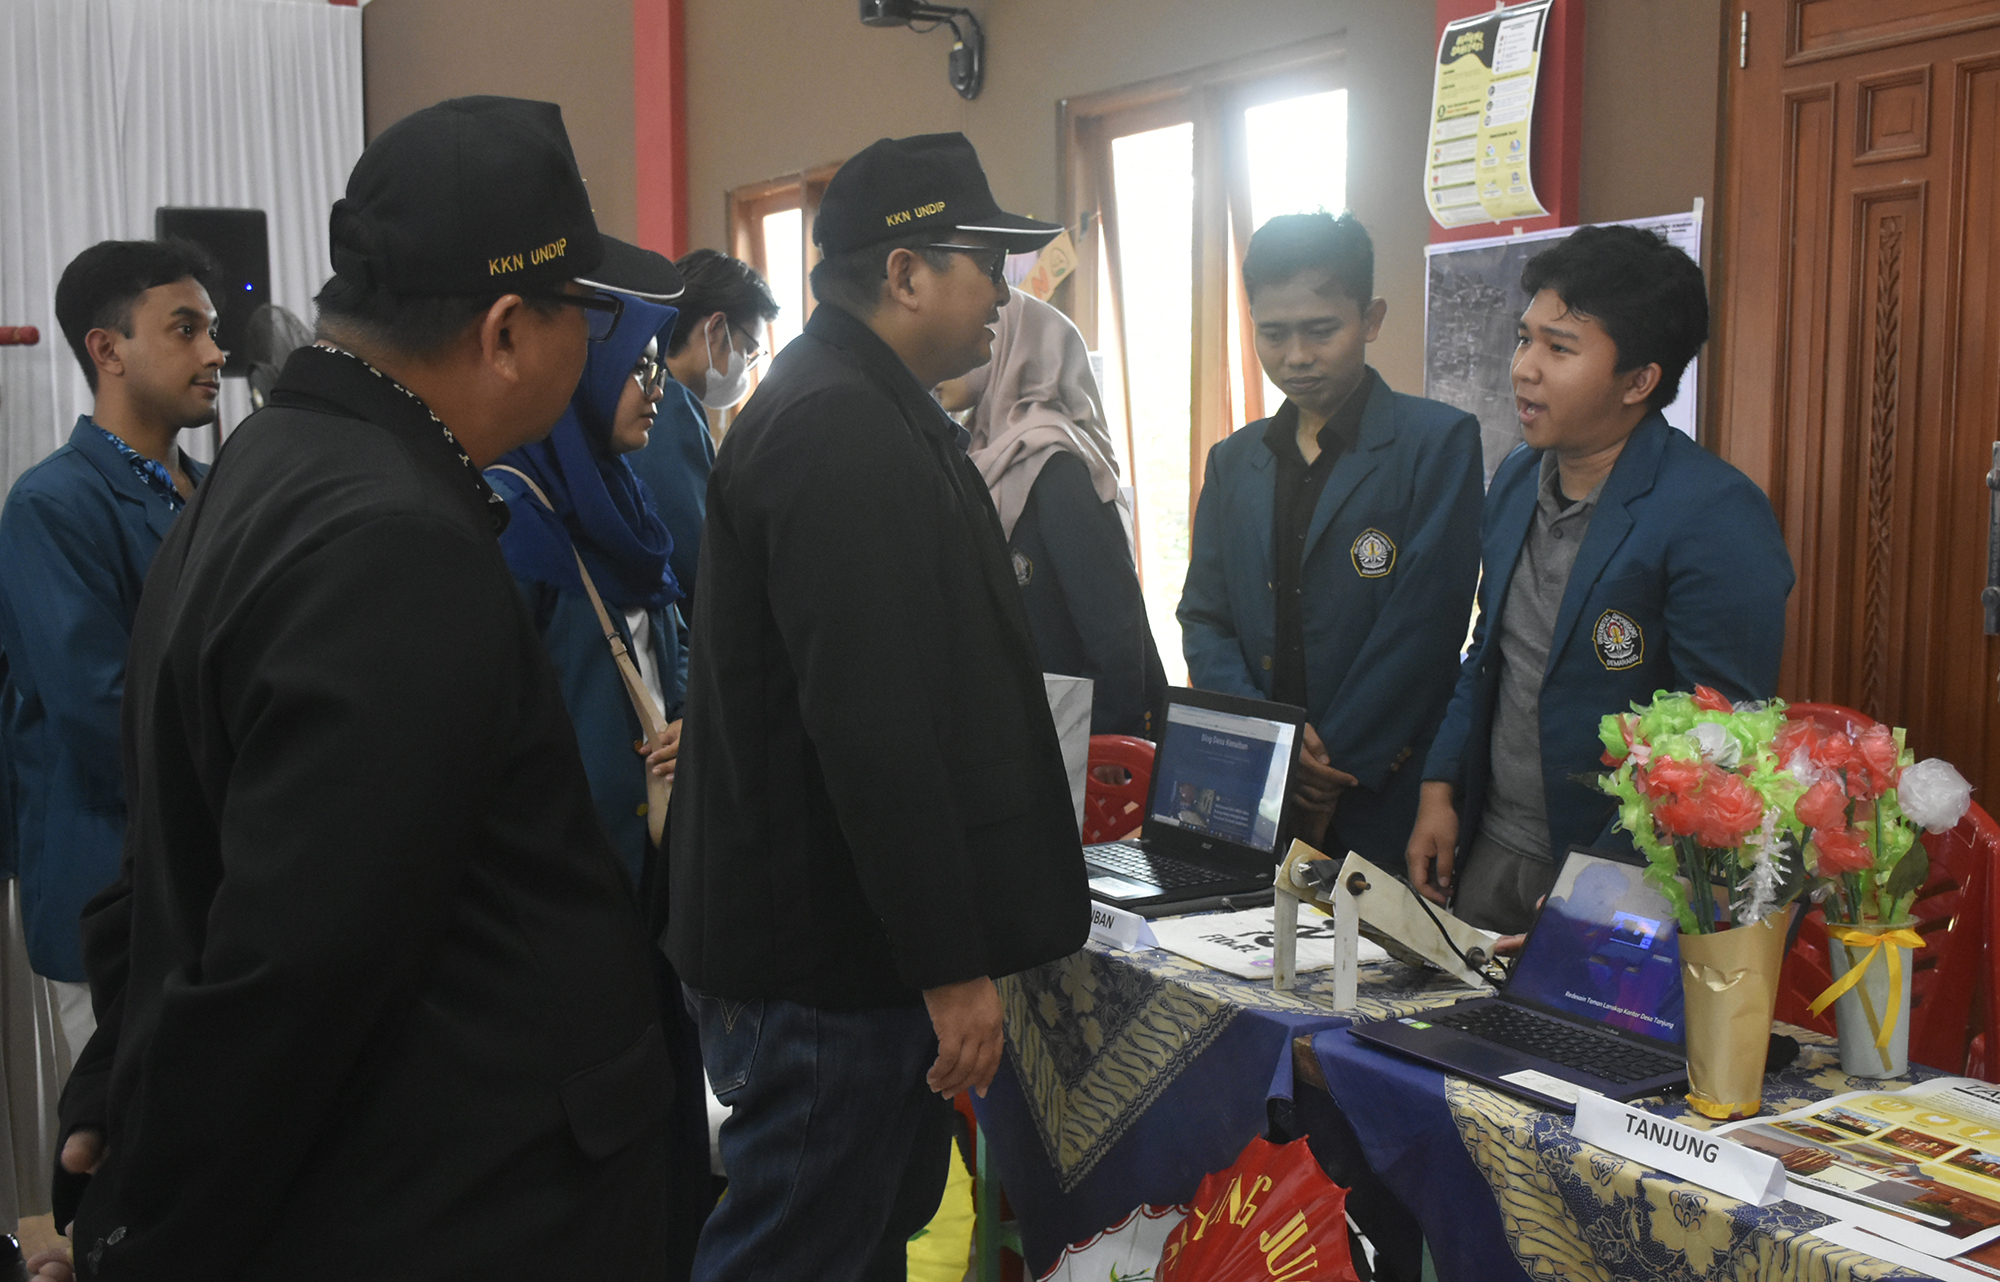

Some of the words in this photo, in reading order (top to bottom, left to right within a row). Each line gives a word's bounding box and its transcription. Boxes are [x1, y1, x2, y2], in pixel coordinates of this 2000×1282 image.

[885, 210, 911, 227] KKN
[914, 201, 946, 218] UNDIP
[489, 253, 524, 276] KKN
[530, 237, 567, 265] UNDIP
[1606, 653, 1639, 667] SEMARANG
[1587, 996, 1603, 1007] Taman
[1603, 1002, 1624, 1014] Lanskap
[1623, 1008, 1640, 1018] Kantor
[1640, 1013, 1654, 1022] Desa
[1653, 1017, 1675, 1029] Tanjung
[1625, 1113, 1720, 1164] TANJUNG
